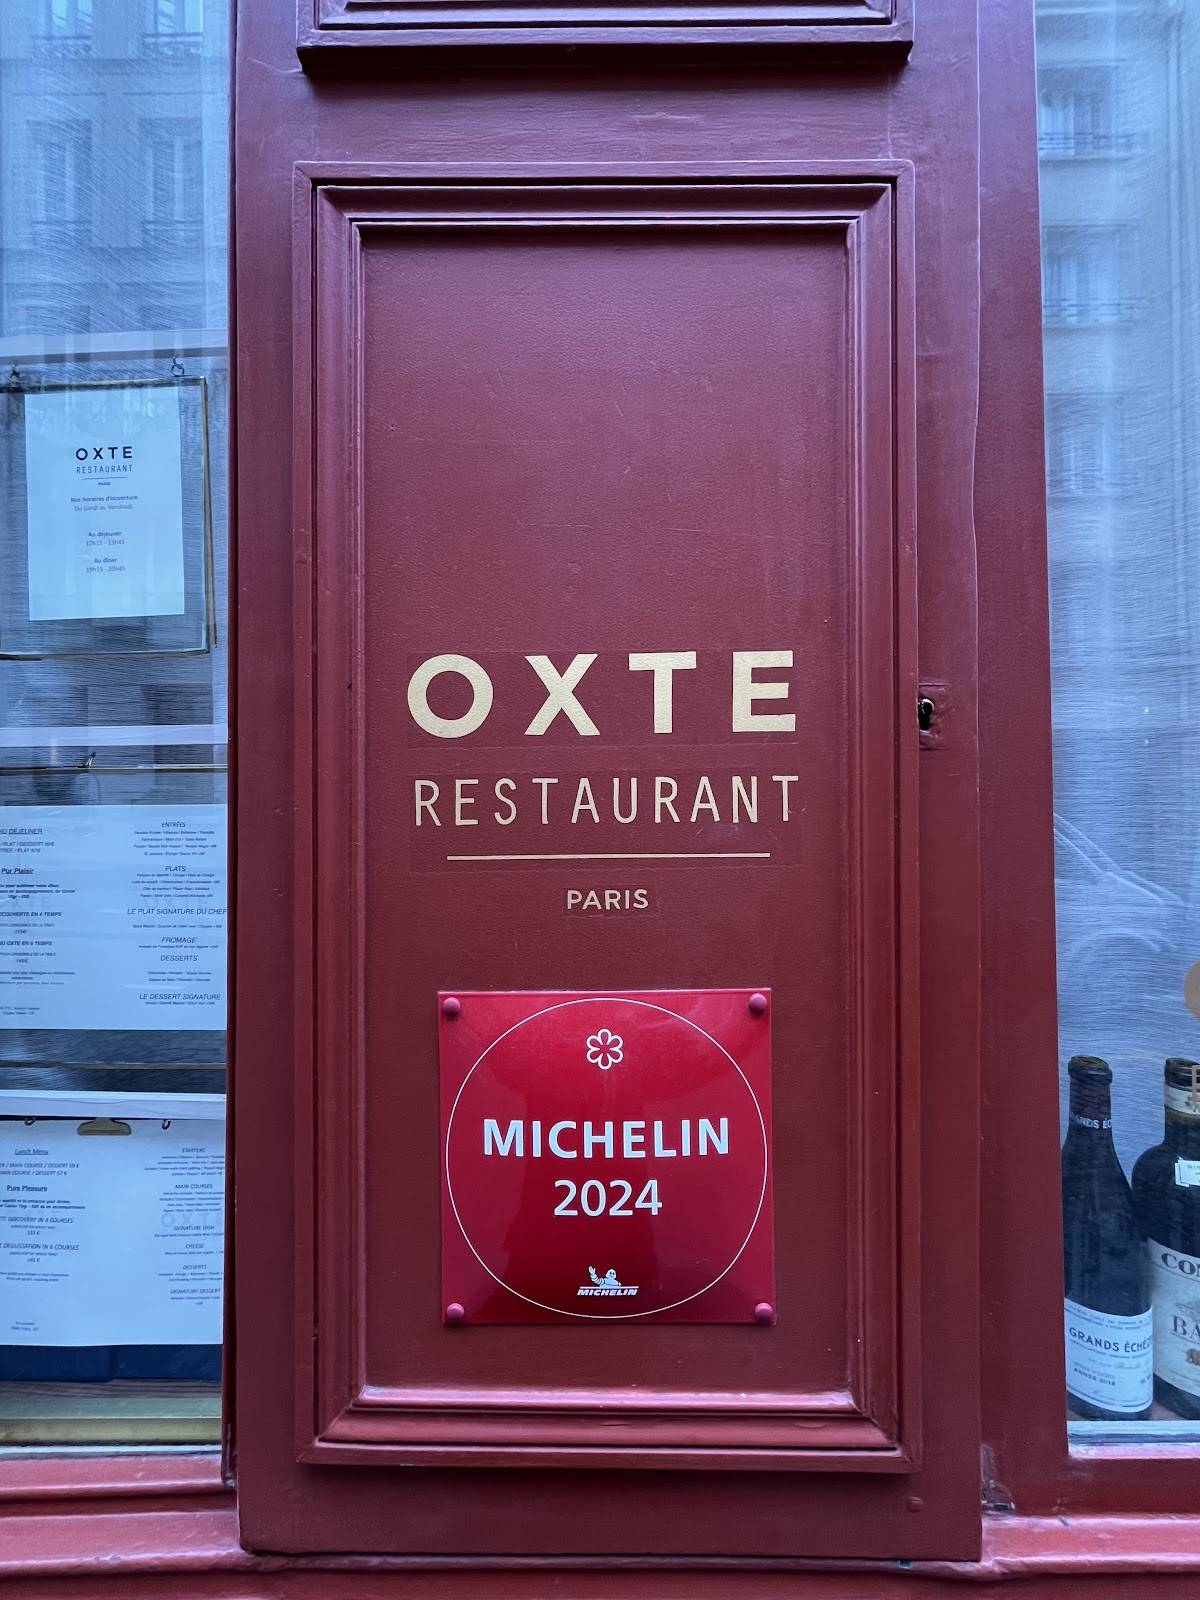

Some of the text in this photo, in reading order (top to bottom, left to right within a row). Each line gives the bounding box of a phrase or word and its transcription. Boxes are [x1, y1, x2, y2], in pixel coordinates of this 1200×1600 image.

[75, 446, 133, 461] OXTE
[76, 464, 133, 474] RESTAURANT
[407, 650, 796, 739] OXTE
[415, 775, 799, 827] RESTAURANT
[566, 888, 649, 910] PARIS
[483, 1117, 729, 1159] MICHELIN
[554, 1179, 662, 1216] 2024
[1069, 1326, 1120, 1352] GRANDS
